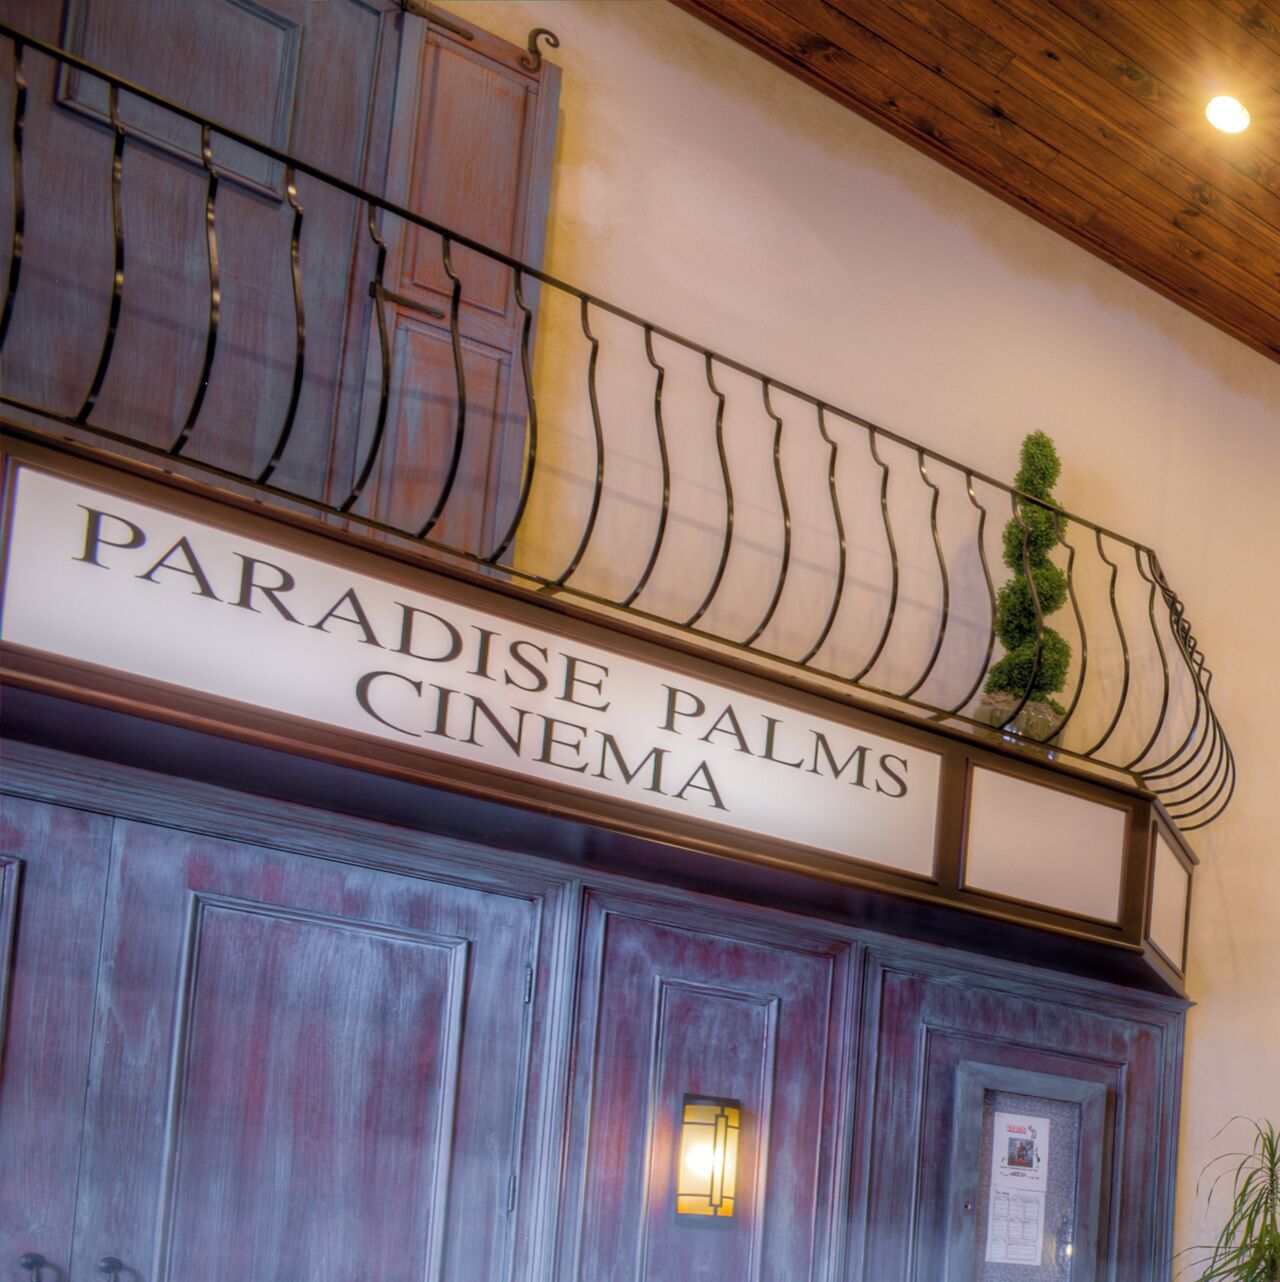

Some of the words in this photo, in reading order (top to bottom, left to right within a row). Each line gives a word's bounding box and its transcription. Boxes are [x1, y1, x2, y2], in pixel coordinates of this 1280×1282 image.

[71, 503, 611, 712] PARADISE
[657, 683, 911, 799] PALMS
[354, 670, 732, 812] CINEMA
